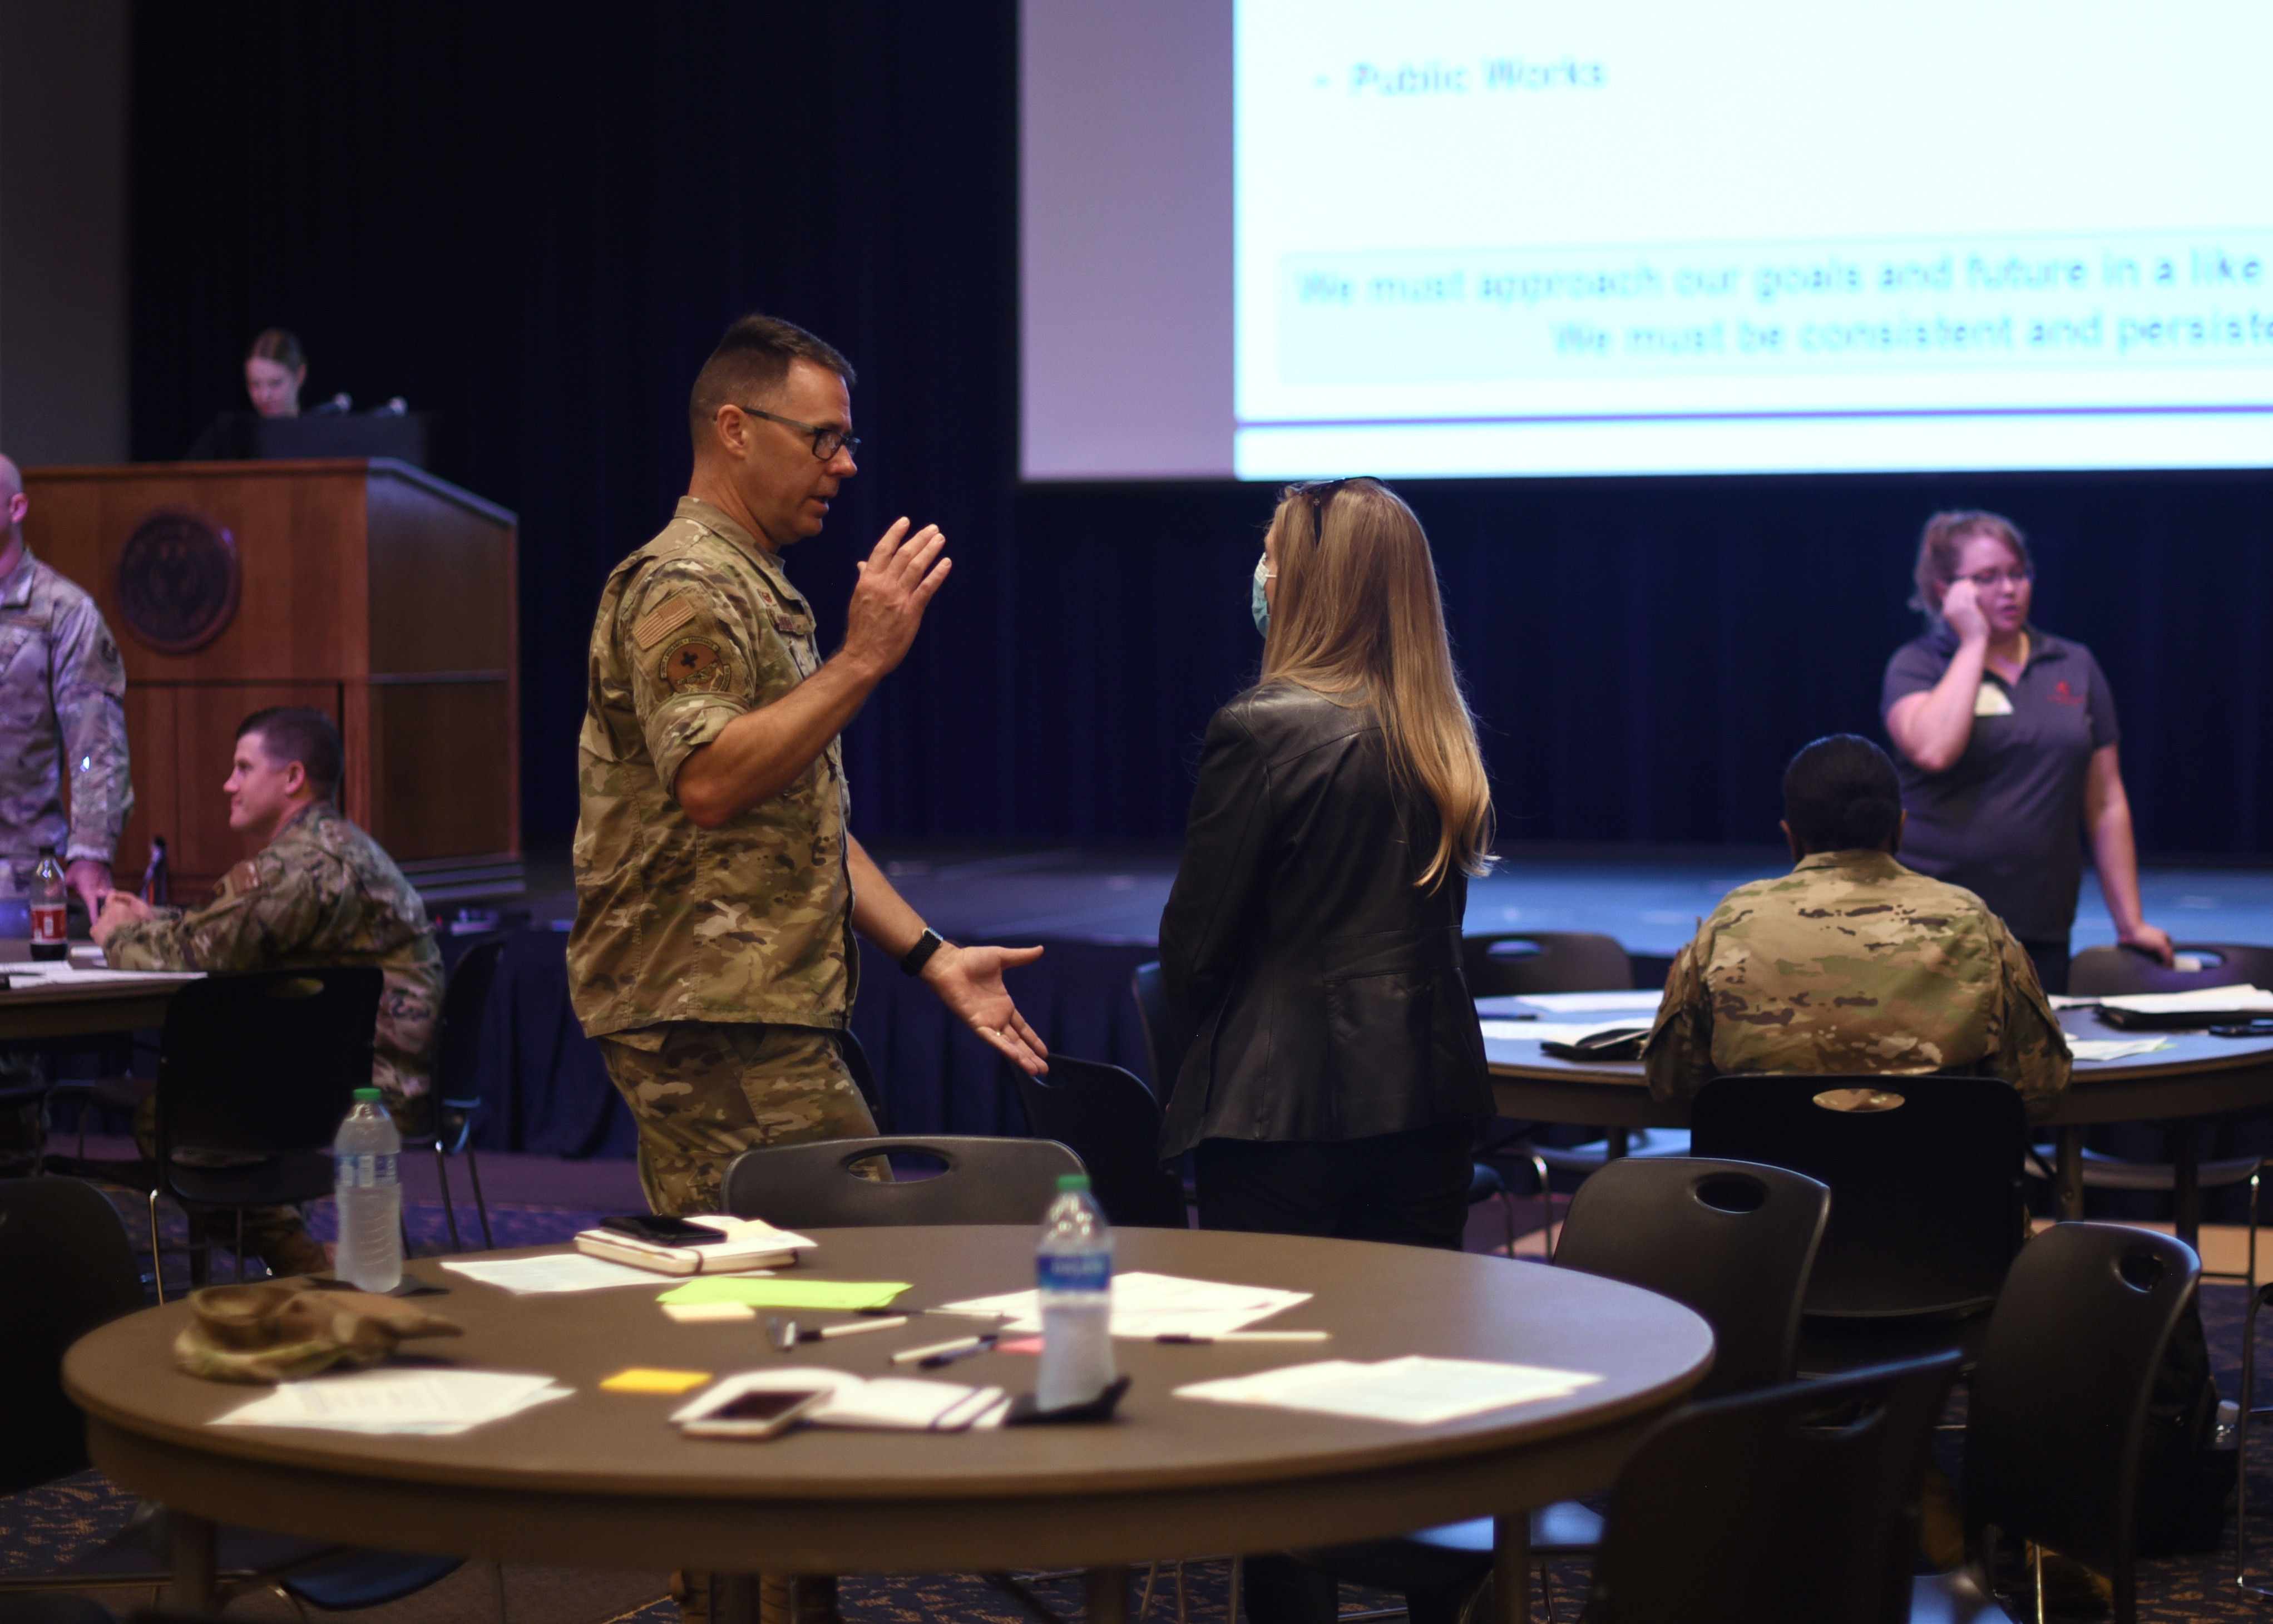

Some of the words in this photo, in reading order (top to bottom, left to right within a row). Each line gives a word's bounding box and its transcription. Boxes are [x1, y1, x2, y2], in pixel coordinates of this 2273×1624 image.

[1349, 59, 1470, 97] Public
[1480, 56, 1609, 91] Works
[1295, 270, 1357, 307] We
[1367, 269, 1465, 305] must
[1475, 262, 1663, 309] approach
[1672, 266, 1741, 298] our
[1753, 256, 1865, 306] goals
[1876, 253, 1954, 294] and
[1964, 250, 2089, 292] future
[2101, 248, 2141, 289] in
[2152, 255, 2178, 289] a
[2190, 245, 2265, 288] like
[1550, 320, 1614, 357] We
[1624, 320, 1726, 356] must
[1736, 318, 1787, 355] be
[1797, 312, 2015, 354] consistent
[2025, 308, 2104, 350] and
